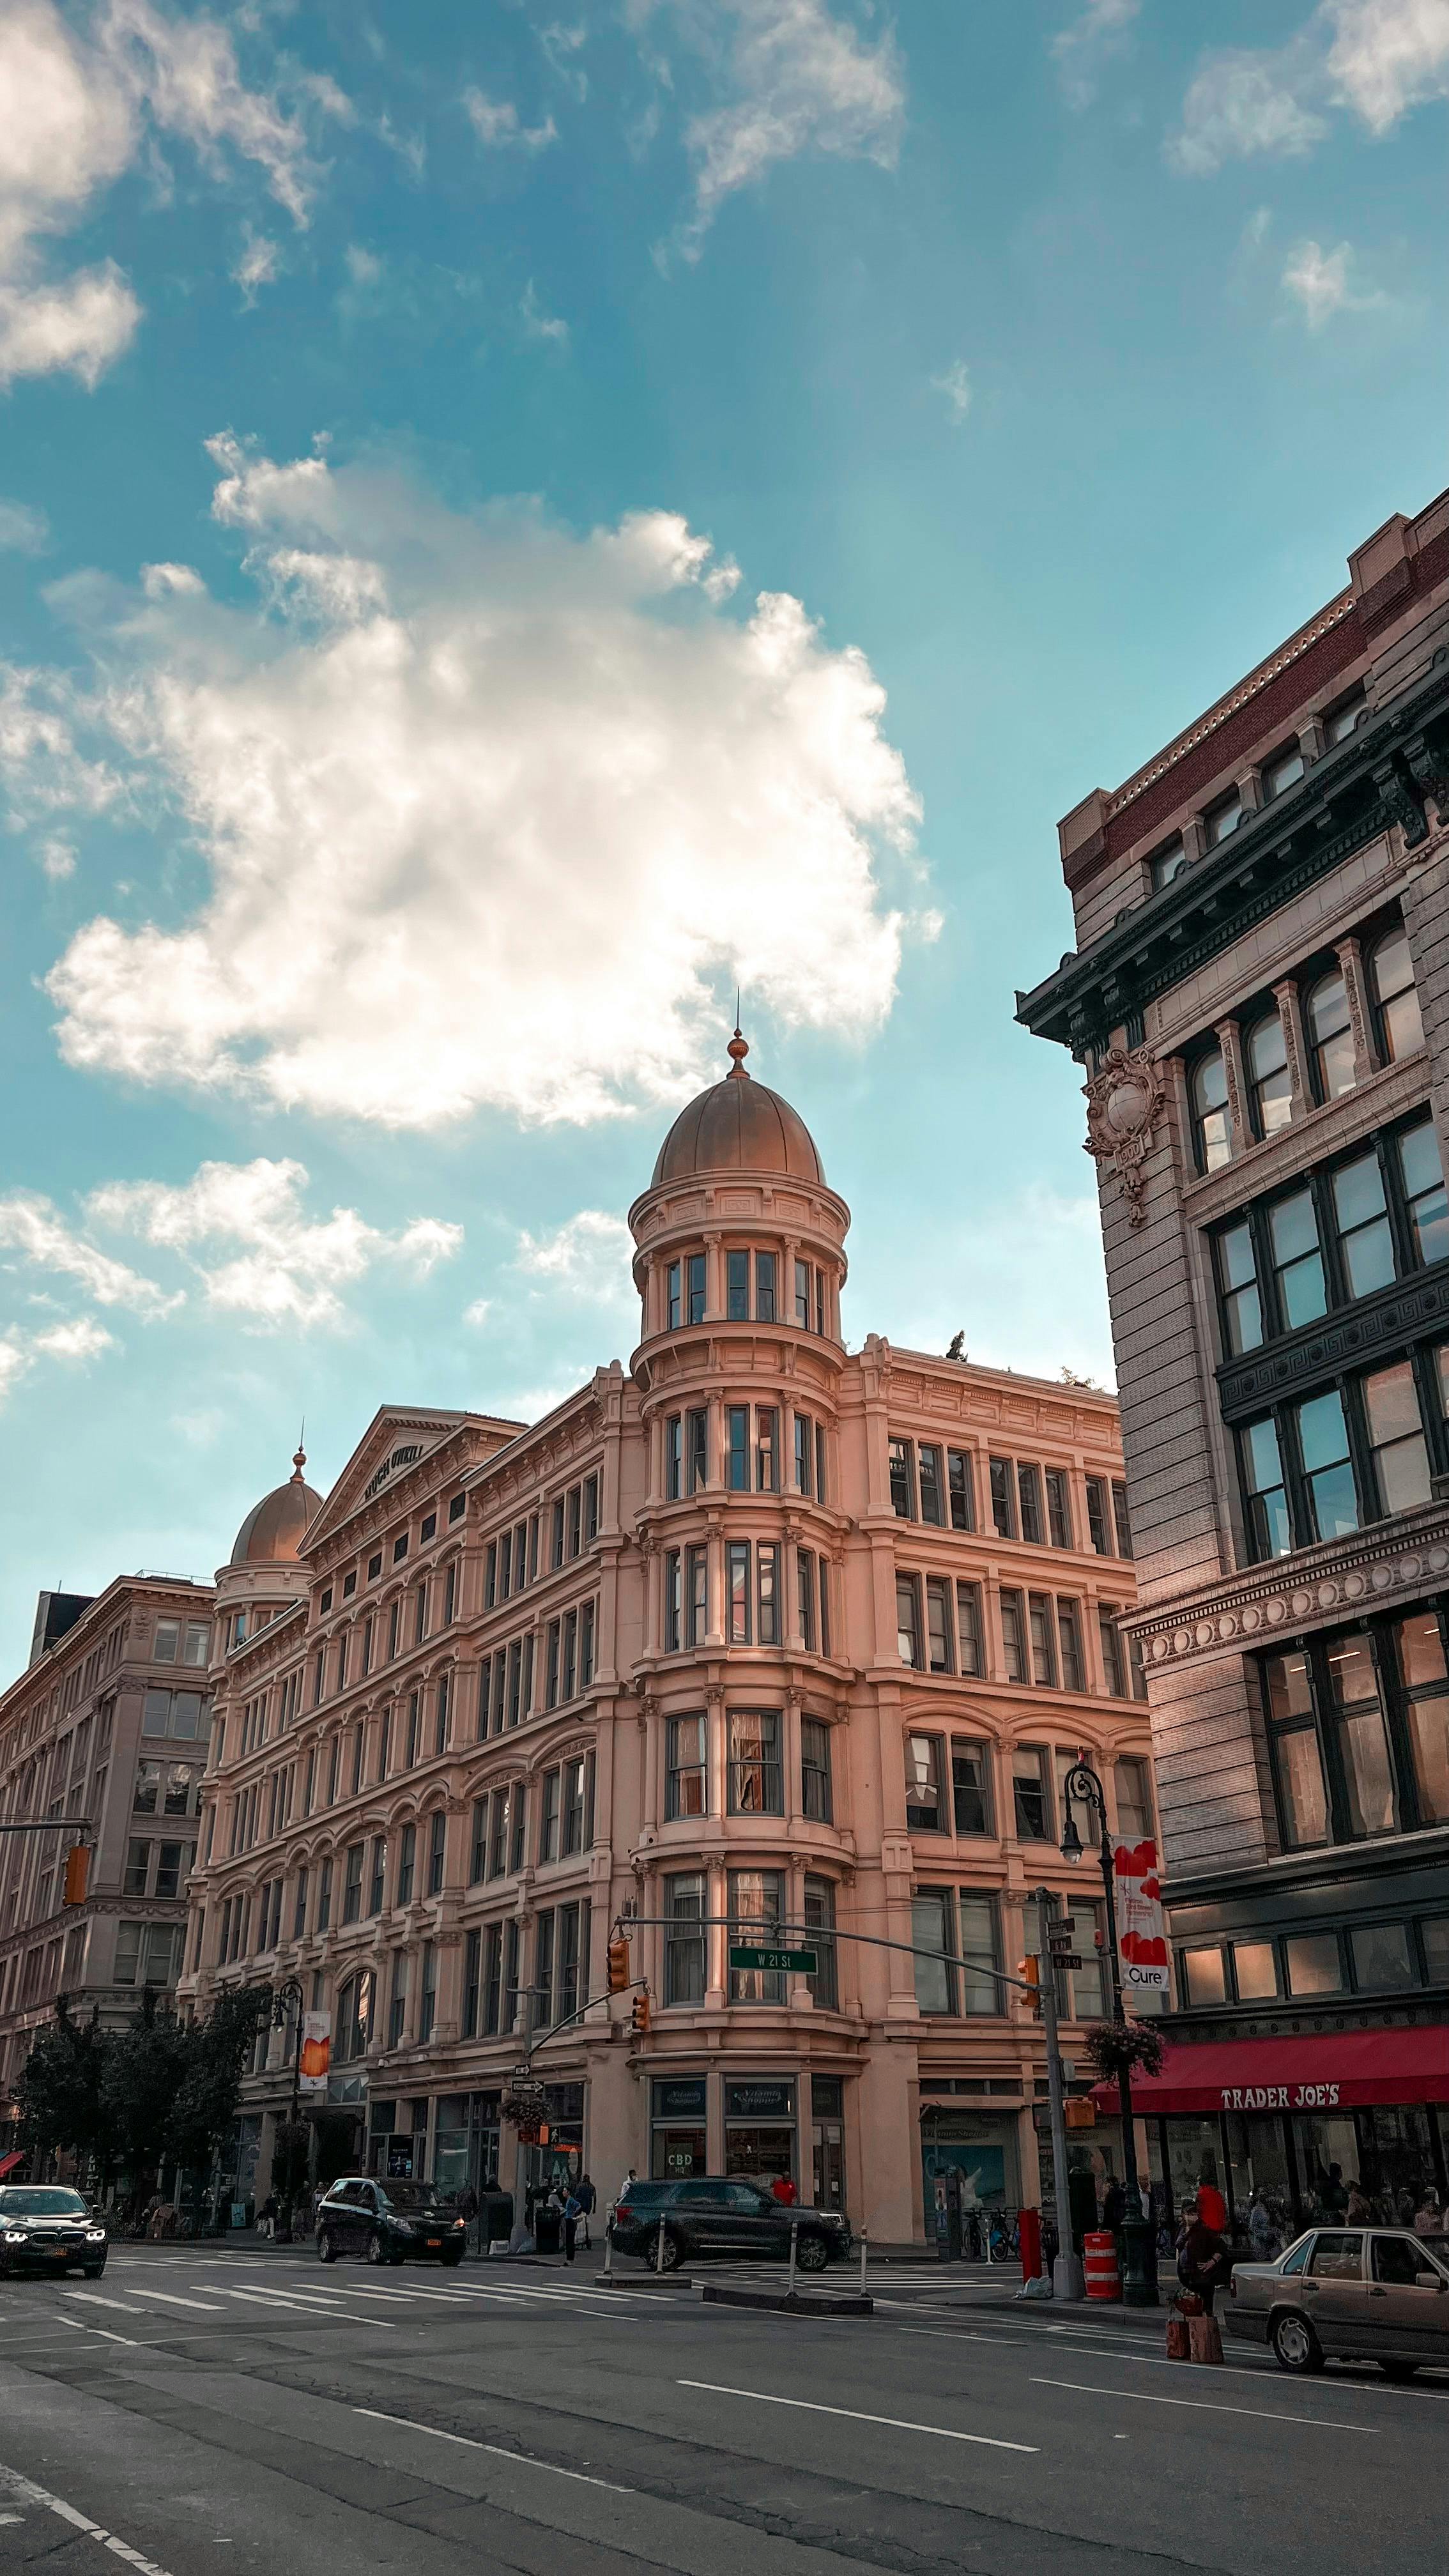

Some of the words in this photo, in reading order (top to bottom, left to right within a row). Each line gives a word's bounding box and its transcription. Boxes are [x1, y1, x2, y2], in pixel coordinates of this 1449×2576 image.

[1119, 1143, 1139, 1164] 1900
[757, 1954, 765, 1966] W
[769, 1954, 778, 1966] 21
[781, 1956, 791, 1968] St
[1055, 1958, 1062, 1968] W
[1064, 1958, 1071, 1968] 21
[1073, 1958, 1079, 1968] St
[1221, 2087, 1290, 2109] TRADER
[1294, 2083, 1340, 2106] JOE'S
[668, 2154, 693, 2165] CBD
